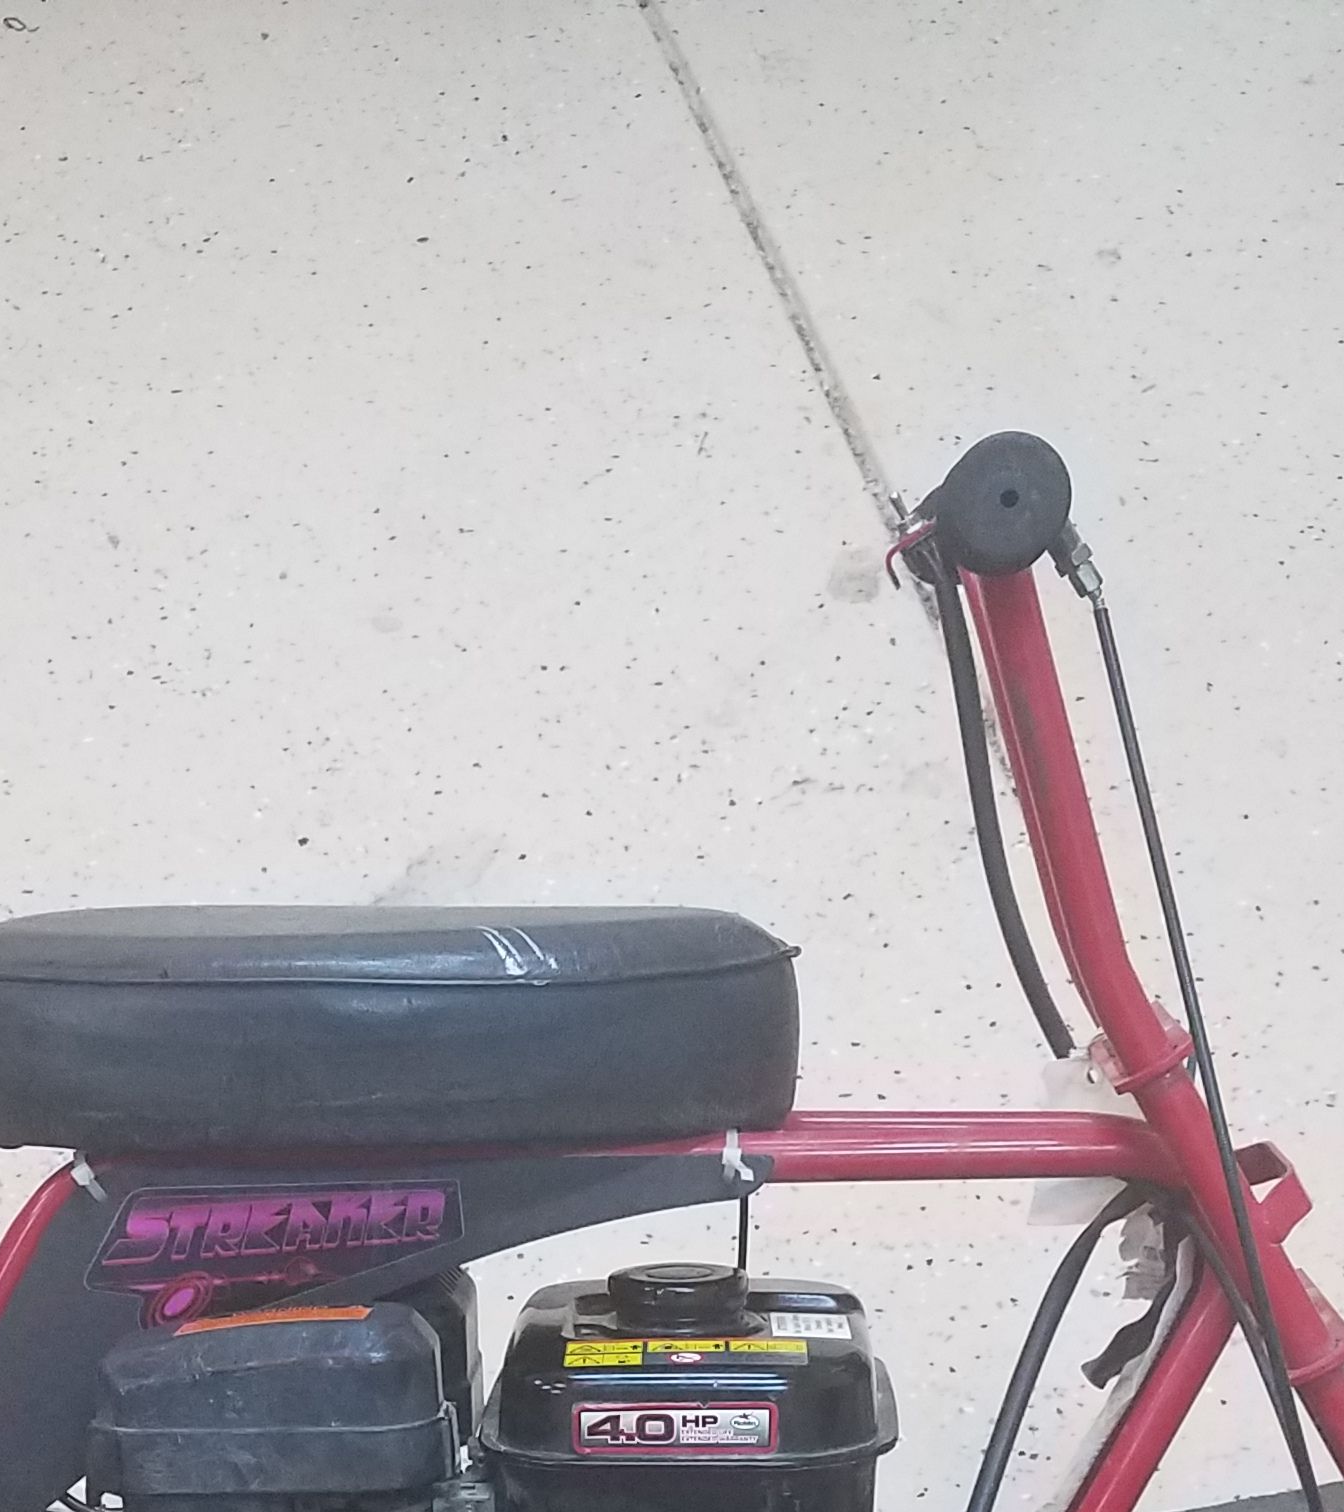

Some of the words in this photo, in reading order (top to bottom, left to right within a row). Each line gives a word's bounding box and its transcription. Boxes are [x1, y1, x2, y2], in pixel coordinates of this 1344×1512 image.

[102, 1190, 446, 1266] STREAKER
[585, 1413, 675, 1443] 4.0
[681, 1414, 719, 1429] HP
